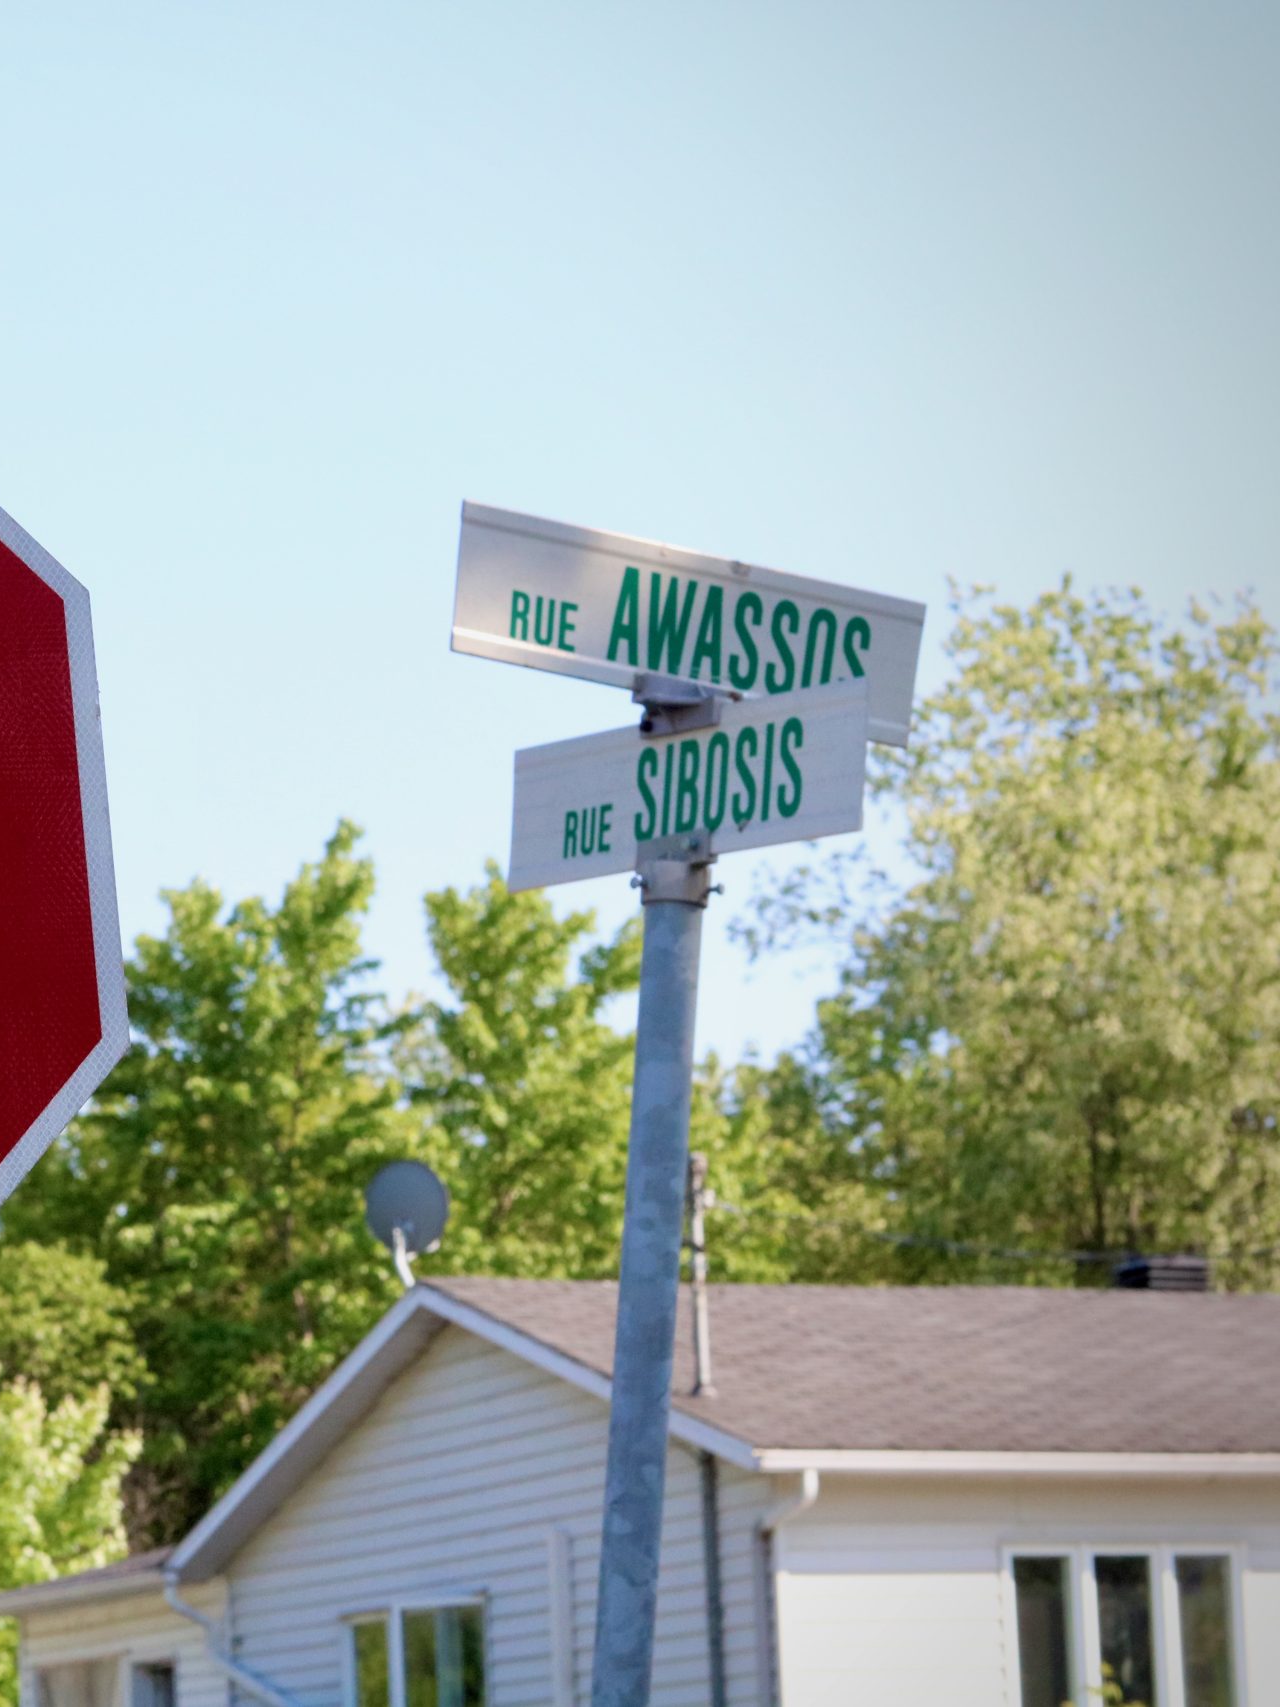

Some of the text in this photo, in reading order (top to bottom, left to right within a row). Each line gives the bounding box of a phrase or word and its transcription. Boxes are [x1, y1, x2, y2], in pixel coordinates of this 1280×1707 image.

[508, 590, 579, 653] RUE
[562, 715, 805, 859] RUE SIBOSIS
